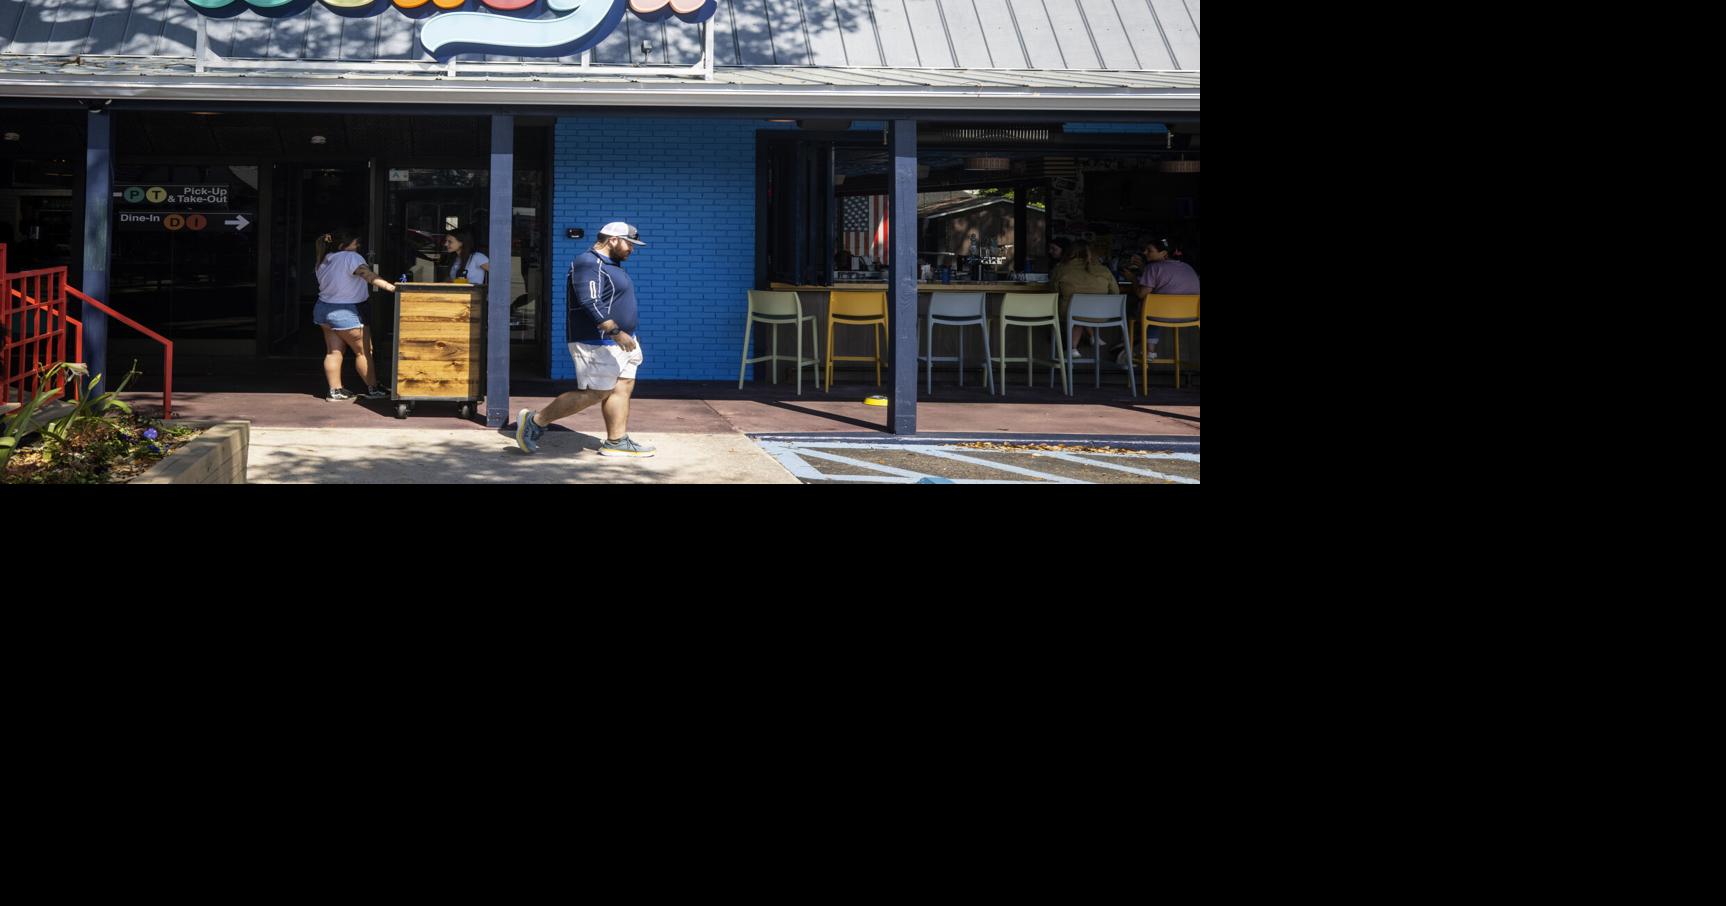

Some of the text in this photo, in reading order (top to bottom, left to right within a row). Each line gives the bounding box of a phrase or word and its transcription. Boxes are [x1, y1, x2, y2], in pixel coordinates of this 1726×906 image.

[184, 187, 228, 196] Pick-Up
[167, 195, 228, 203] & Take-Out
[120, 214, 160, 222] Dine-In
